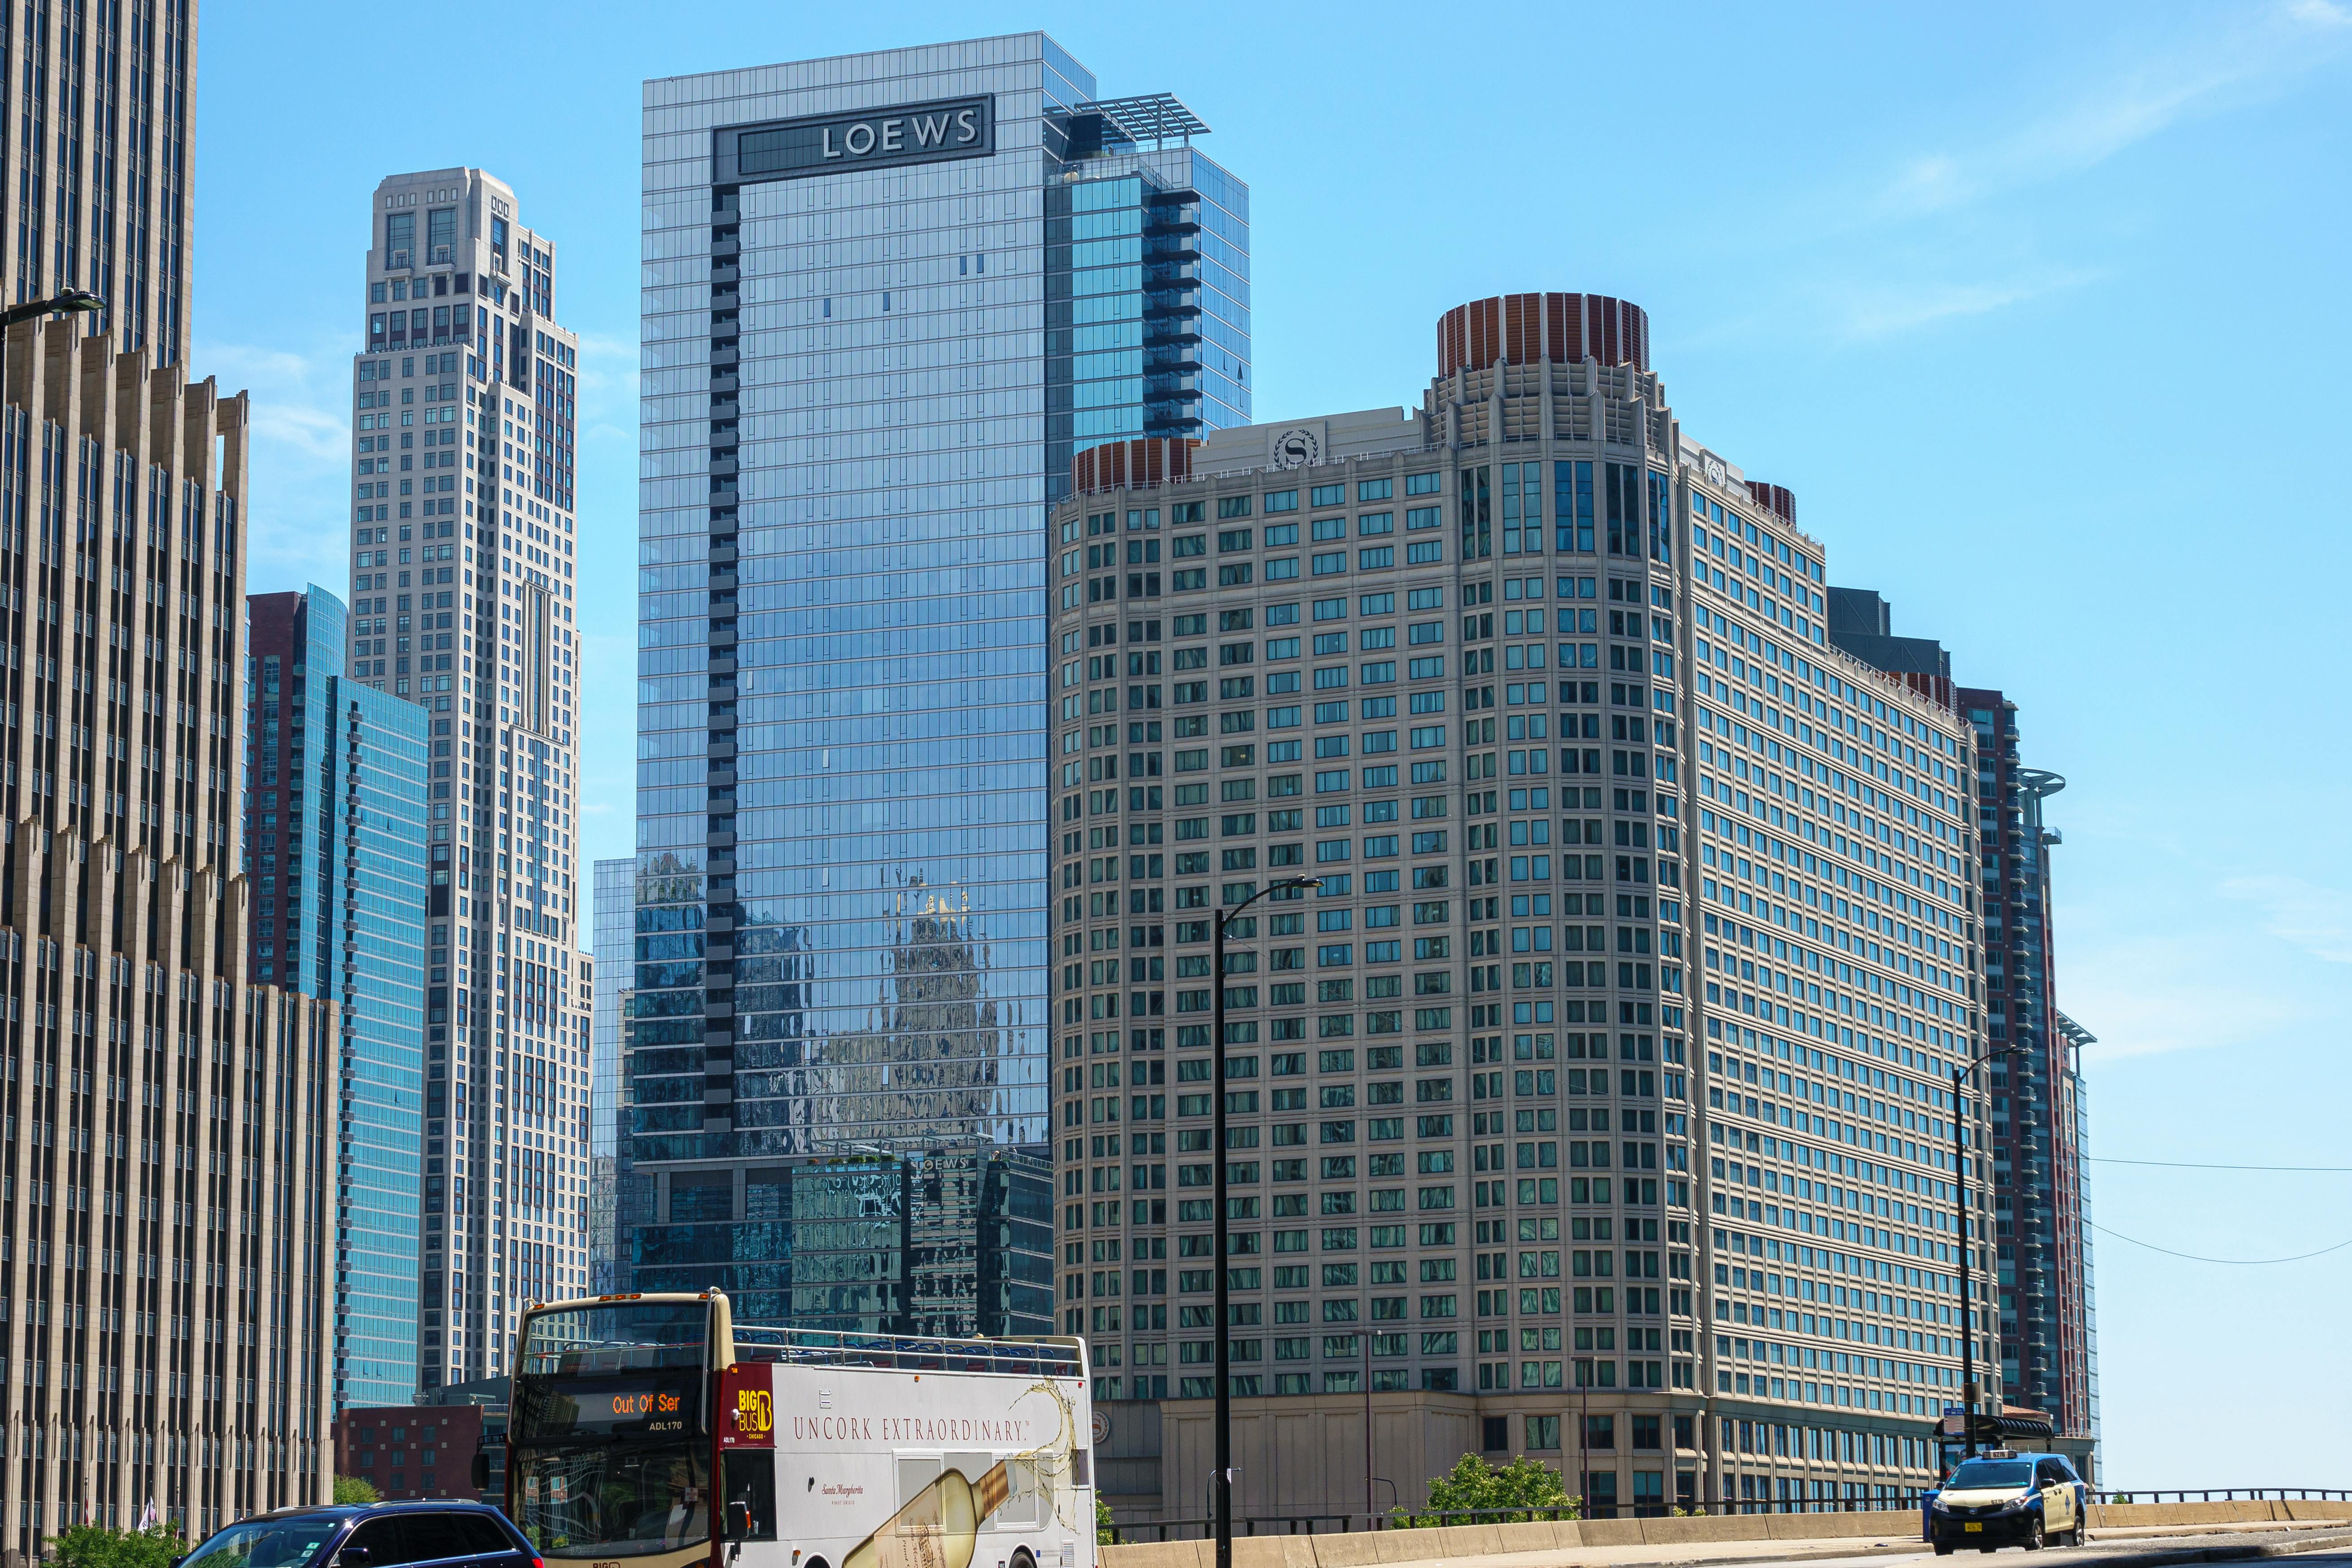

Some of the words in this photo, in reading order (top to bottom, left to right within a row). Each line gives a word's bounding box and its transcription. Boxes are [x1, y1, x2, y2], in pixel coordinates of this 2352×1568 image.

[823, 110, 977, 157] LOEWS
[916, 1157, 966, 1170] LOEWS
[613, 1395, 634, 1414] Out
[639, 1394, 654, 1412] Of
[659, 1393, 680, 1411] Ser
[738, 1390, 757, 1411] BIG
[649, 1421, 682, 1431] ADL170
[739, 1412, 758, 1431] BUS
[794, 1416, 872, 1440] UNCORK
[821, 1483, 836, 1495] Santa
[836, 1484, 864, 1498] Margherita
